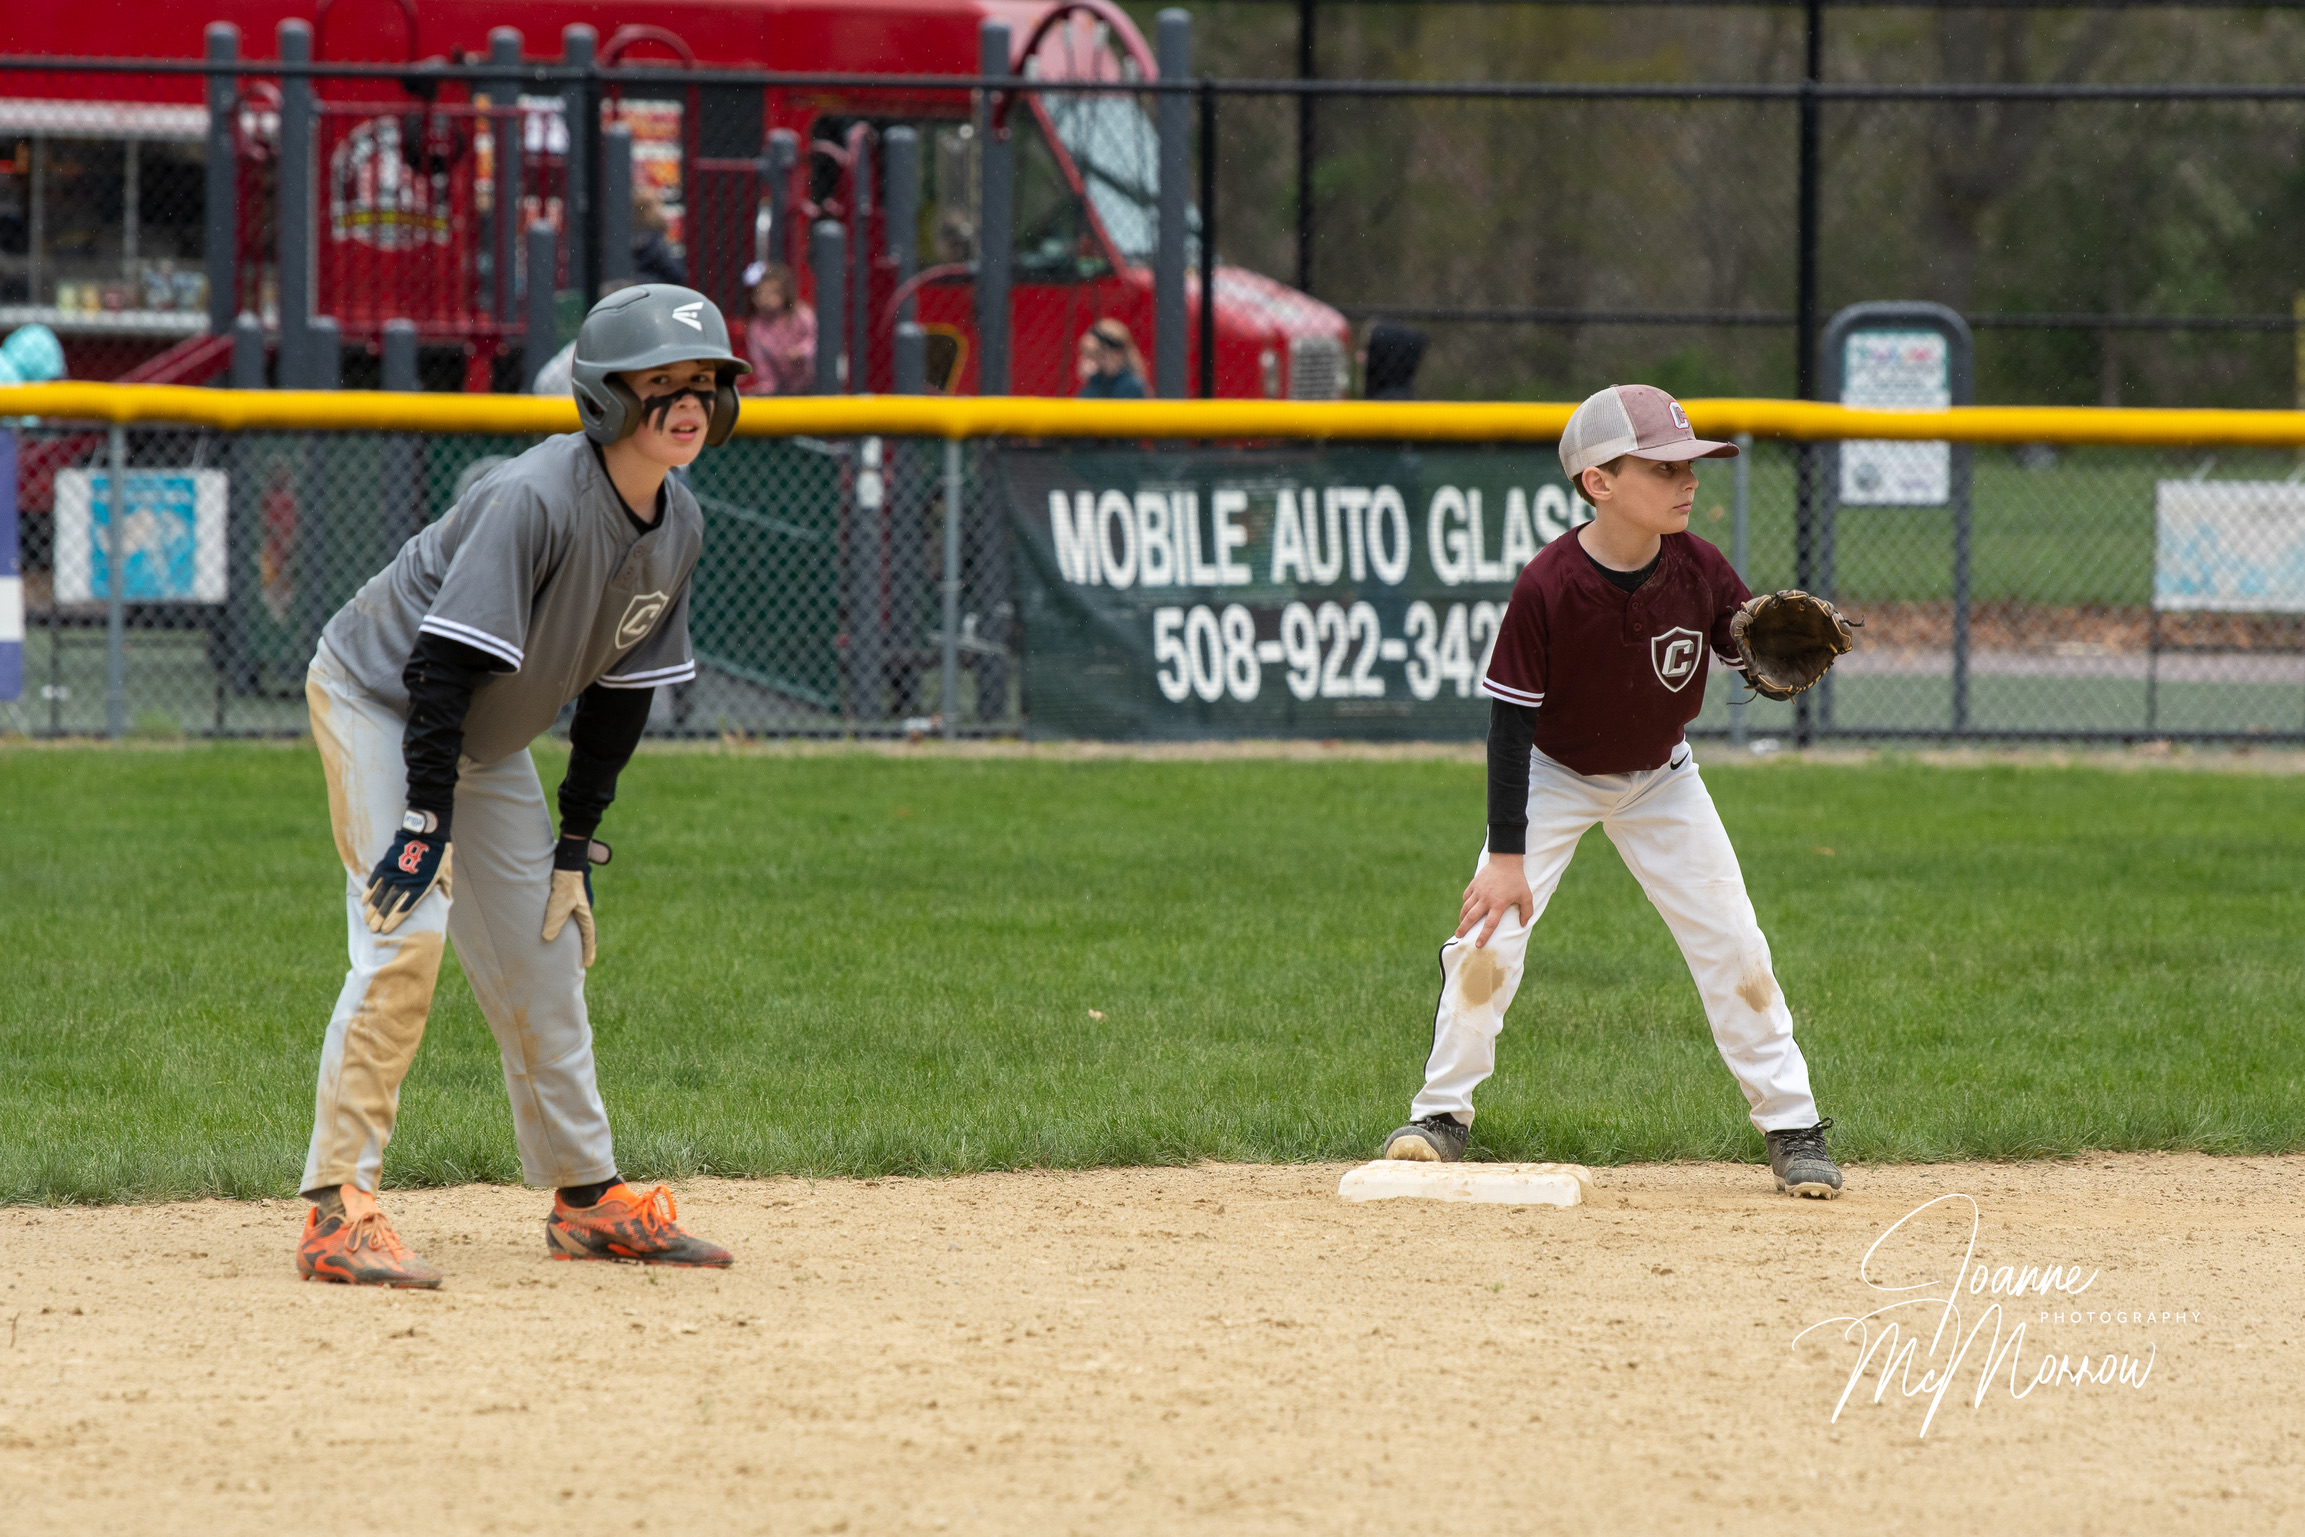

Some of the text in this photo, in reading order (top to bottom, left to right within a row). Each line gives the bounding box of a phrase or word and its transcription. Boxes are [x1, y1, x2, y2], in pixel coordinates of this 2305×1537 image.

[1668, 400, 1690, 430] C
[1049, 488, 1252, 589] MOBILE
[1270, 484, 1411, 586] AUTO
[622, 604, 661, 634] C
[1152, 600, 1513, 702] 508-922-342
[1662, 639, 1695, 678] C
[398, 840, 430, 874] B
